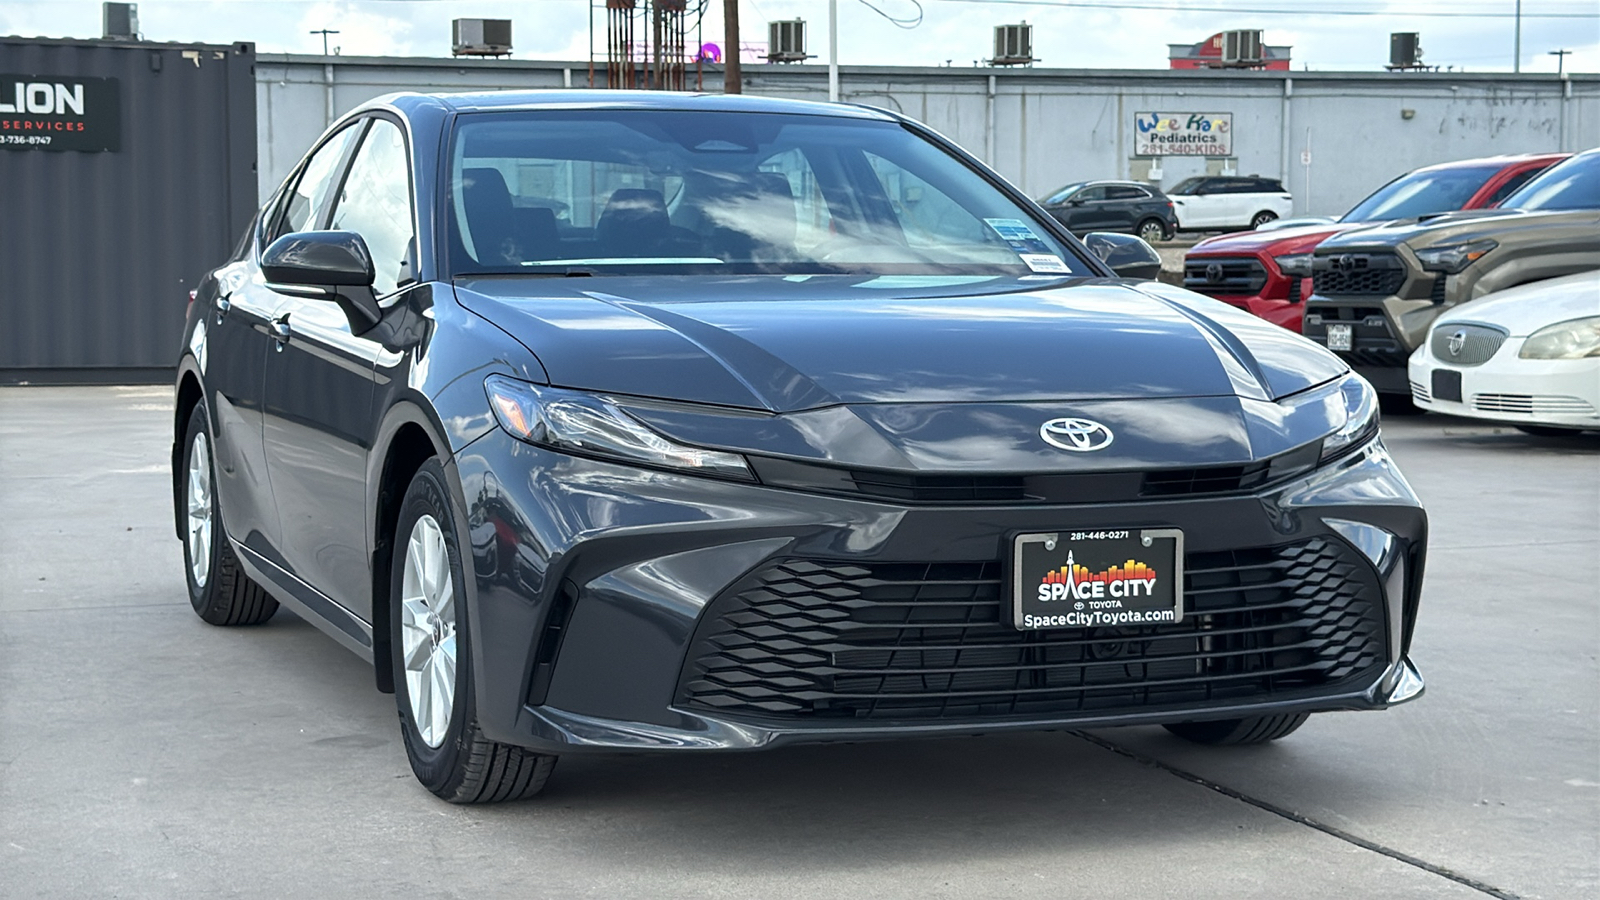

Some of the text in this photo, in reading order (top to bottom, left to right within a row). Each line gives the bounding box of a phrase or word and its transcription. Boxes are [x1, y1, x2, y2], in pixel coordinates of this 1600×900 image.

[2, 120, 84, 131] SERVICES
[1138, 112, 1180, 133] Wee
[1150, 133, 1217, 143] Pediatrics
[1142, 144, 1226, 155] 281-540-KIDS
[1070, 531, 1129, 541] 281-446-0271
[1109, 578, 1156, 597] CITY
[1088, 600, 1122, 609] TOYOTA
[1024, 609, 1174, 629] SpaceCityToyota.com
